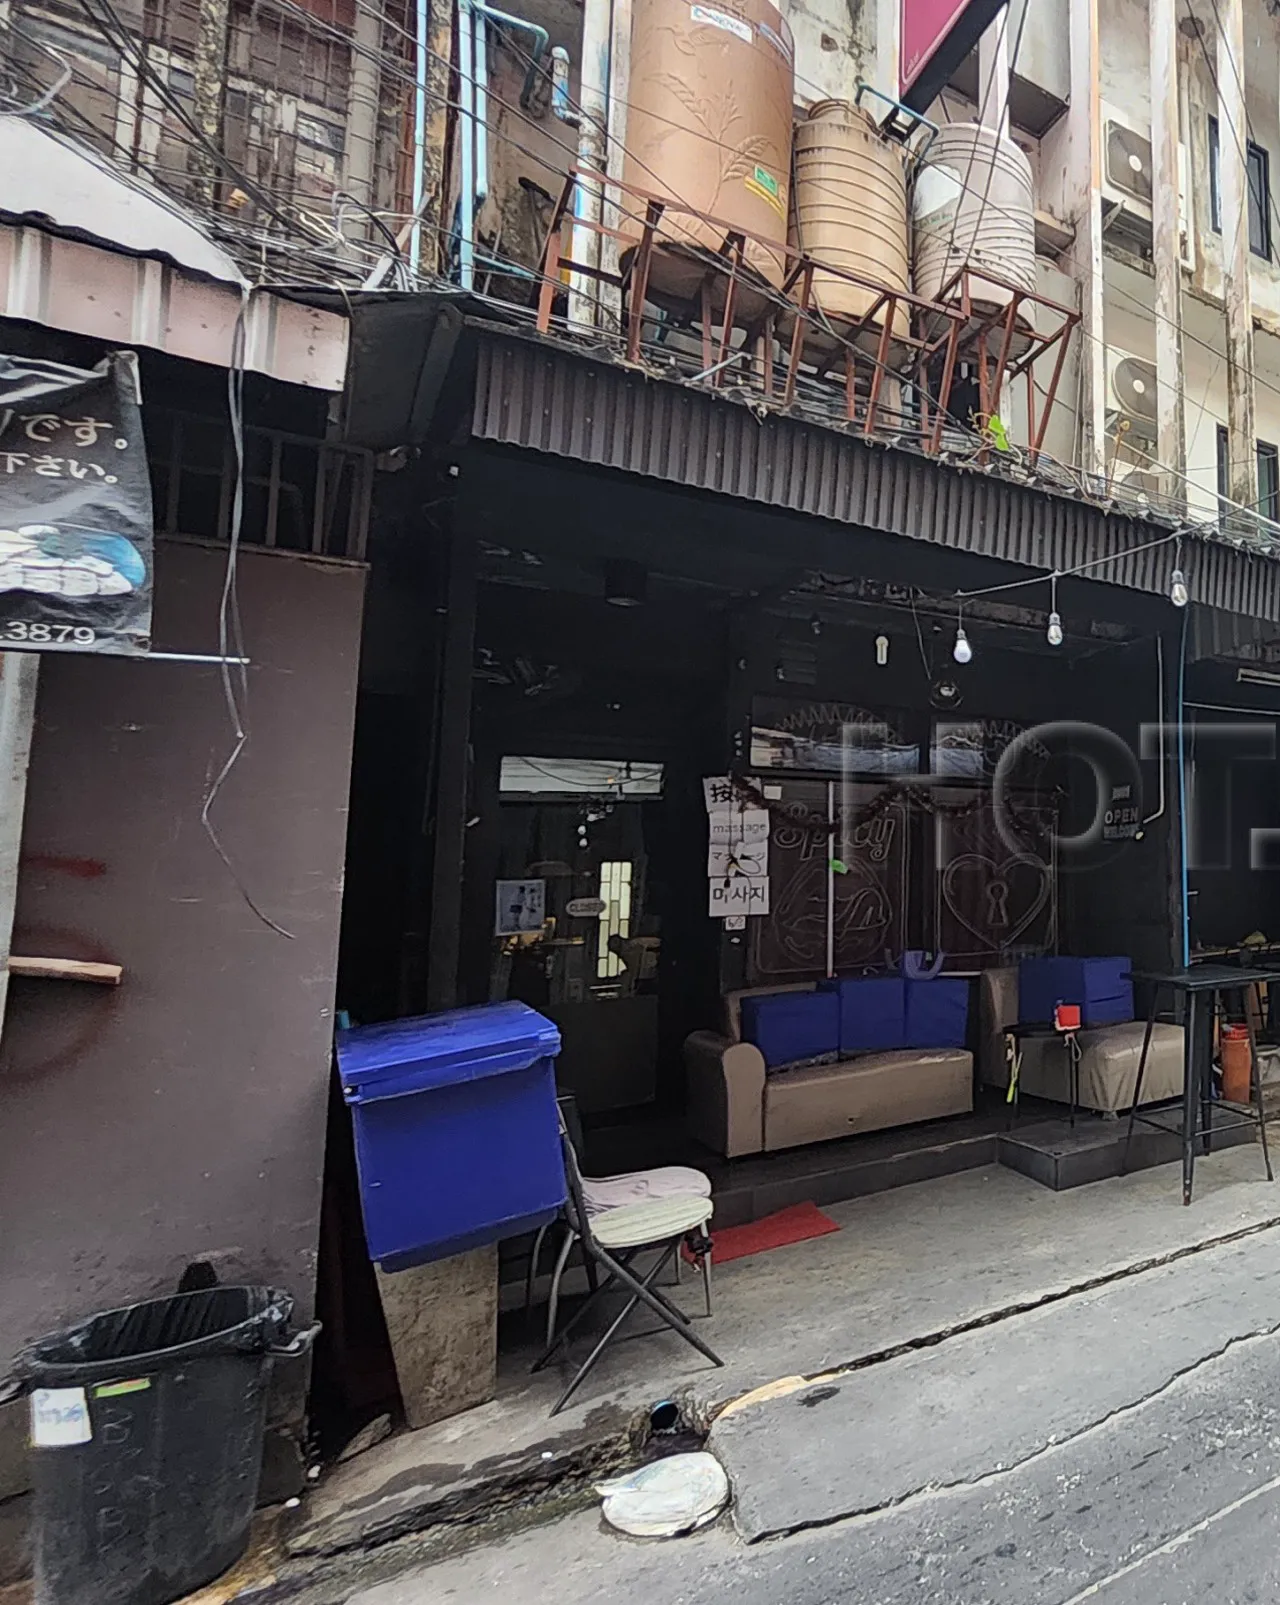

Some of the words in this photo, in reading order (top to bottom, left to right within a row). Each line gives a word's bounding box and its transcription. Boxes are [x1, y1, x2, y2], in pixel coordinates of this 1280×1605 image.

[0, 409, 128, 449] です。
[0, 621, 95, 645] 3879
[1104, 807, 1139, 825] OPEN
